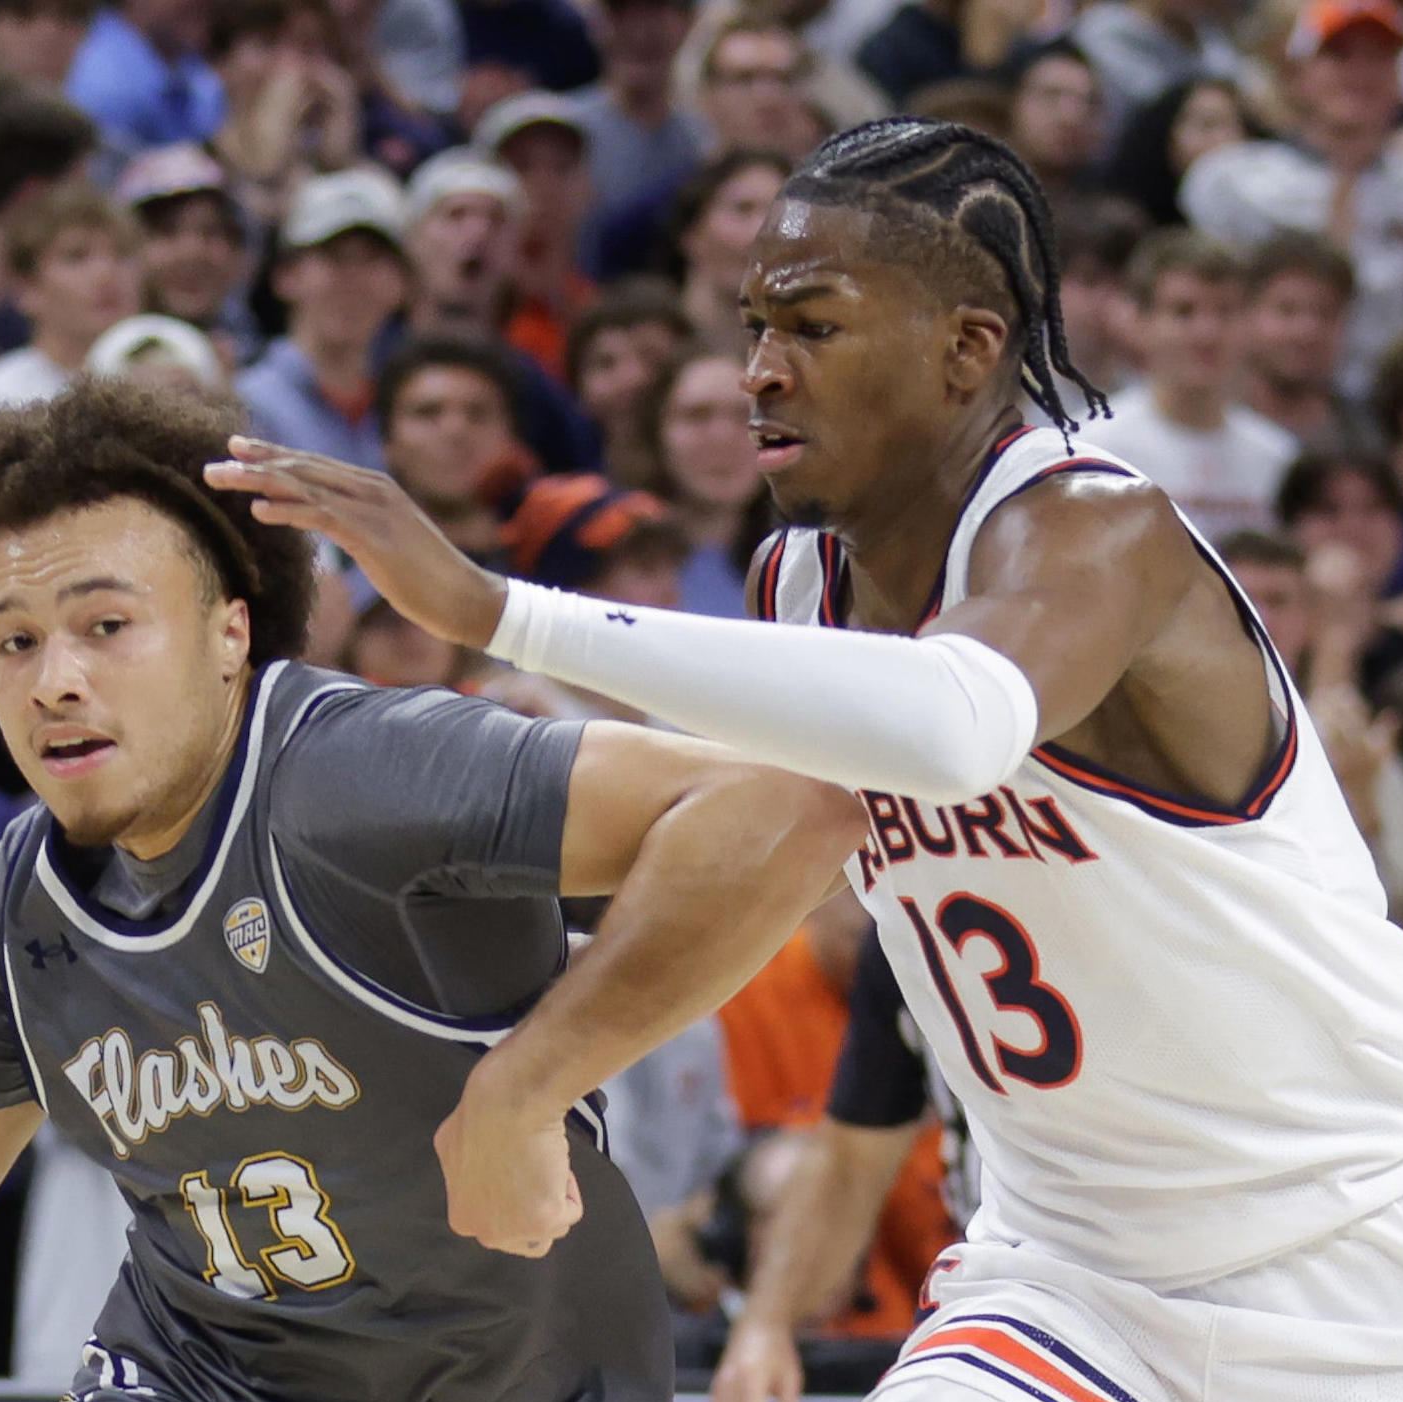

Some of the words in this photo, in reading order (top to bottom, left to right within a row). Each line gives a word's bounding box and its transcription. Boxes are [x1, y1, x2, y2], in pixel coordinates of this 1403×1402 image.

[856, 786, 1100, 894] BURN
[227, 916, 266, 949] MAC
[897, 891, 1084, 1096] 13
[63, 1001, 361, 1160] Flashes
[179, 1150, 356, 1302] 13
